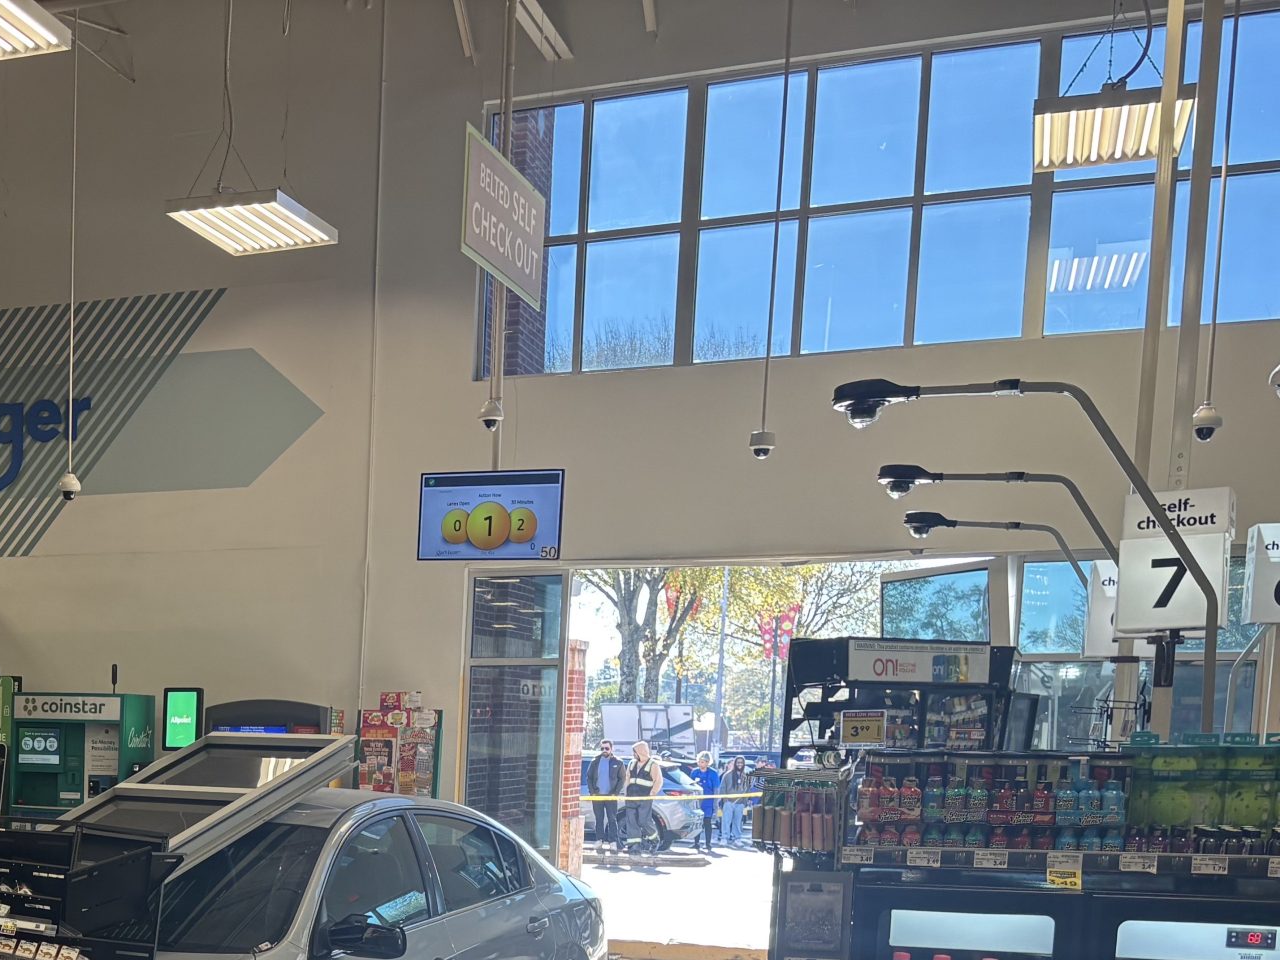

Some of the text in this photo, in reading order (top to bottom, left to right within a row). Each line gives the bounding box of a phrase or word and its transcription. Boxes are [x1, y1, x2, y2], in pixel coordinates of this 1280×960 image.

[480, 162, 536, 236] BELTED SELF
[472, 202, 538, 280] CHECK OUT
[453, 520, 462, 532] 0
[484, 515, 493, 537] 1
[517, 519, 525, 531] 2
[1137, 513, 1217, 530] chckout
[541, 546, 557, 558] 50
[1151, 557, 1188, 609] 7
[873, 658, 898, 677] on!
[41, 698, 106, 715] coinstar
[170, 715, 191, 725] Allpoint
